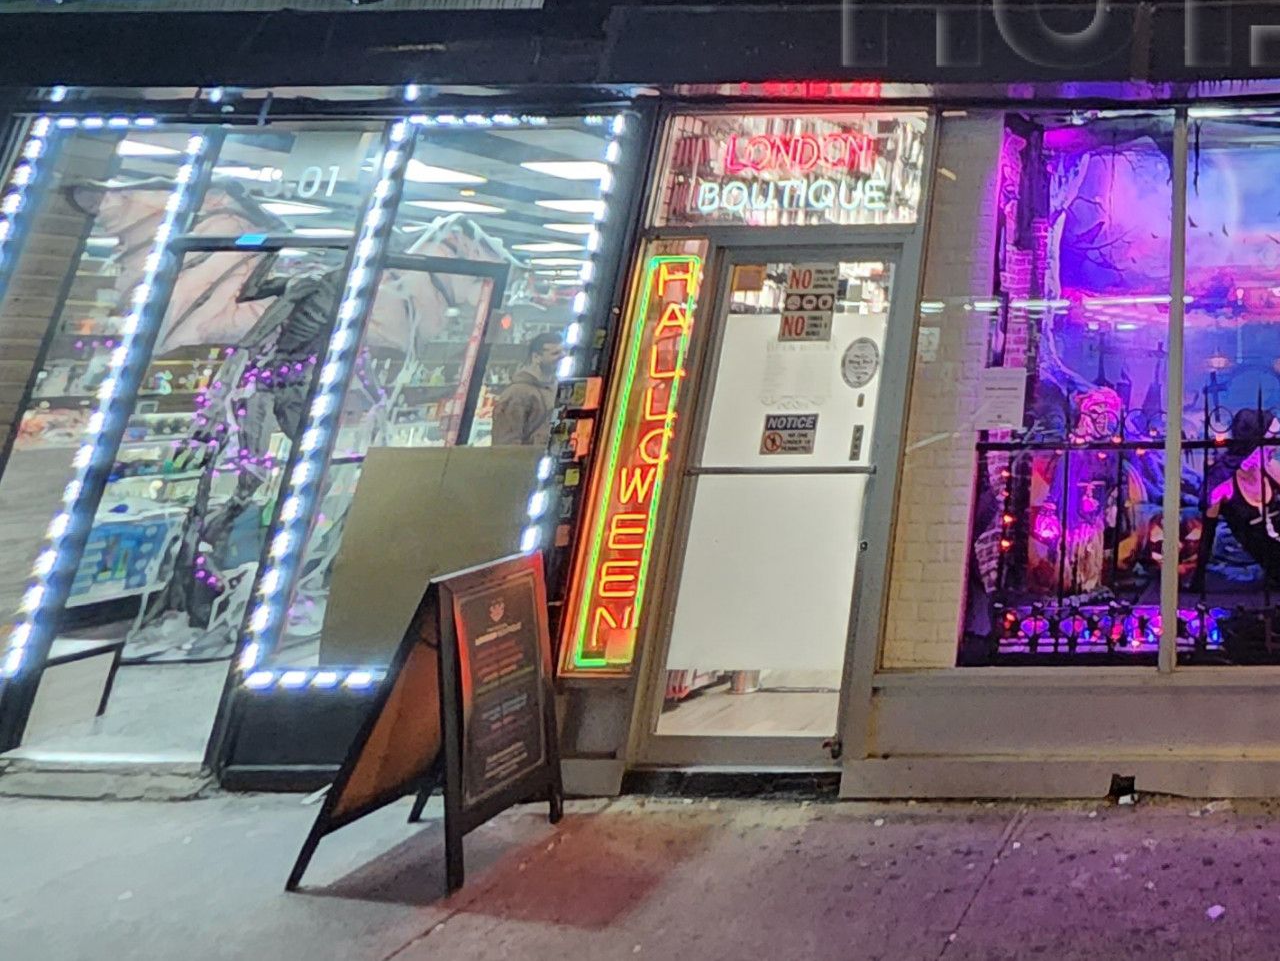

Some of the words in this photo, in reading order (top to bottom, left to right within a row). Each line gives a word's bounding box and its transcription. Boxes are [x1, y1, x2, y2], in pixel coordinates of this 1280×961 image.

[725, 132, 876, 174] LONDON
[697, 177, 888, 213] BOUTIQUE
[789, 269, 813, 289] NO
[781, 315, 806, 337] NO
[768, 416, 815, 429] NOTICE
[591, 260, 697, 647] HALLOWEEN
